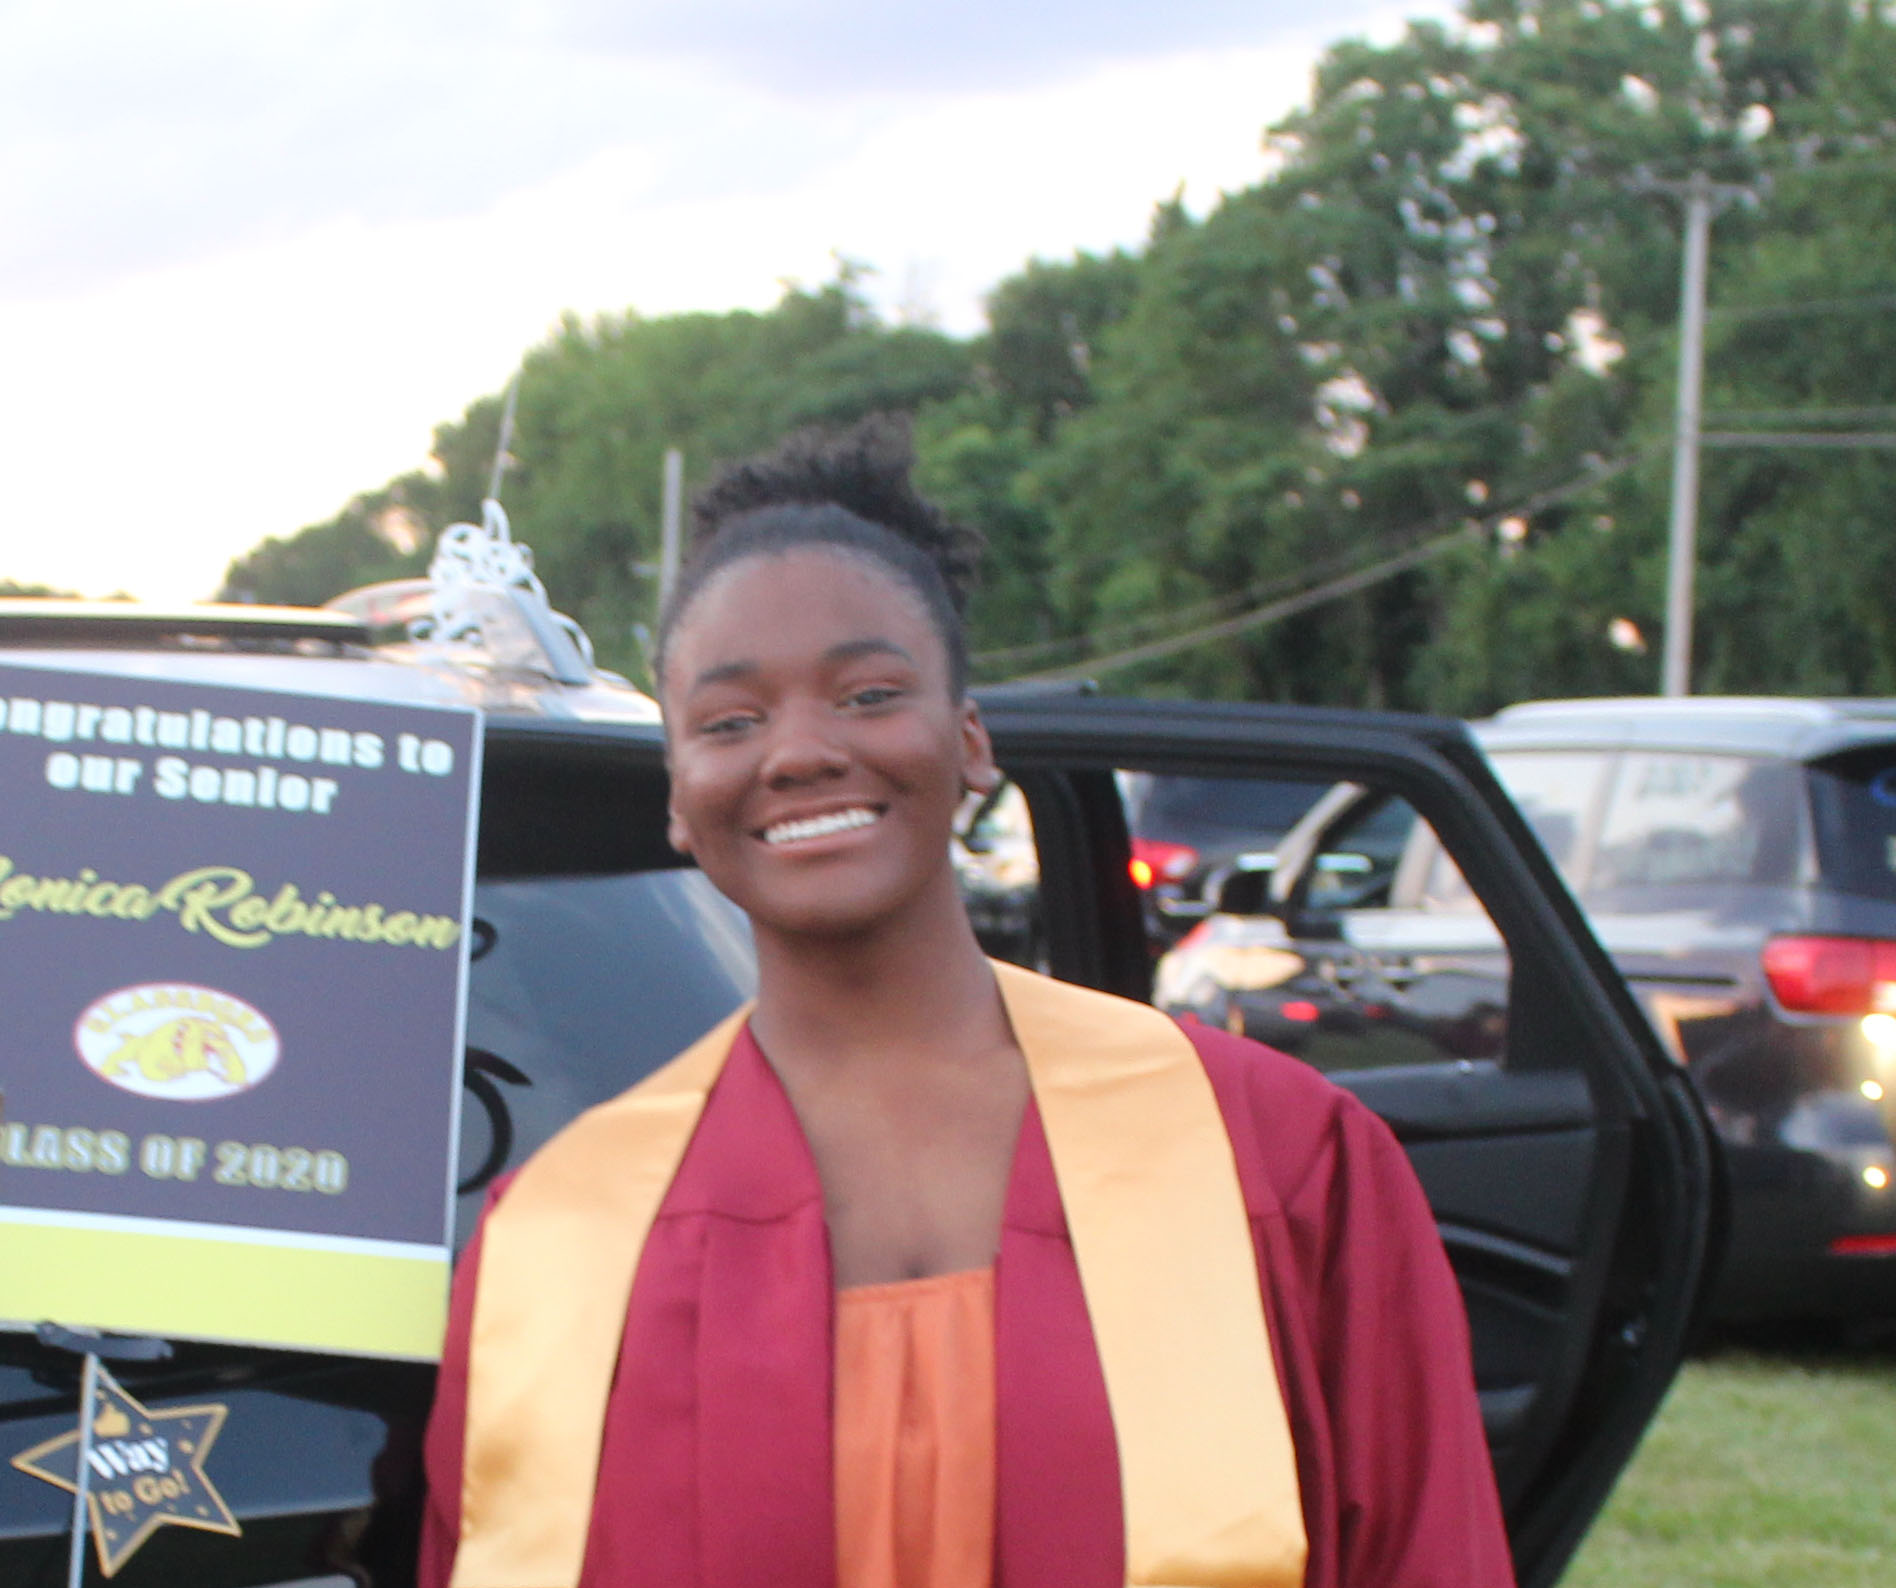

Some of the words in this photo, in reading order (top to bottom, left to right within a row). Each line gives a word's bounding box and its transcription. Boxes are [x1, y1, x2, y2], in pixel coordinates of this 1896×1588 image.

[397, 733, 455, 776] to
[45, 751, 142, 795] our
[153, 756, 339, 814] Senior
[156, 866, 461, 949] Robinson
[140, 1133, 206, 1181] OF
[213, 1141, 350, 1196] 2020
[85, 1437, 169, 1480] Way
[133, 1468, 190, 1505] Go!
